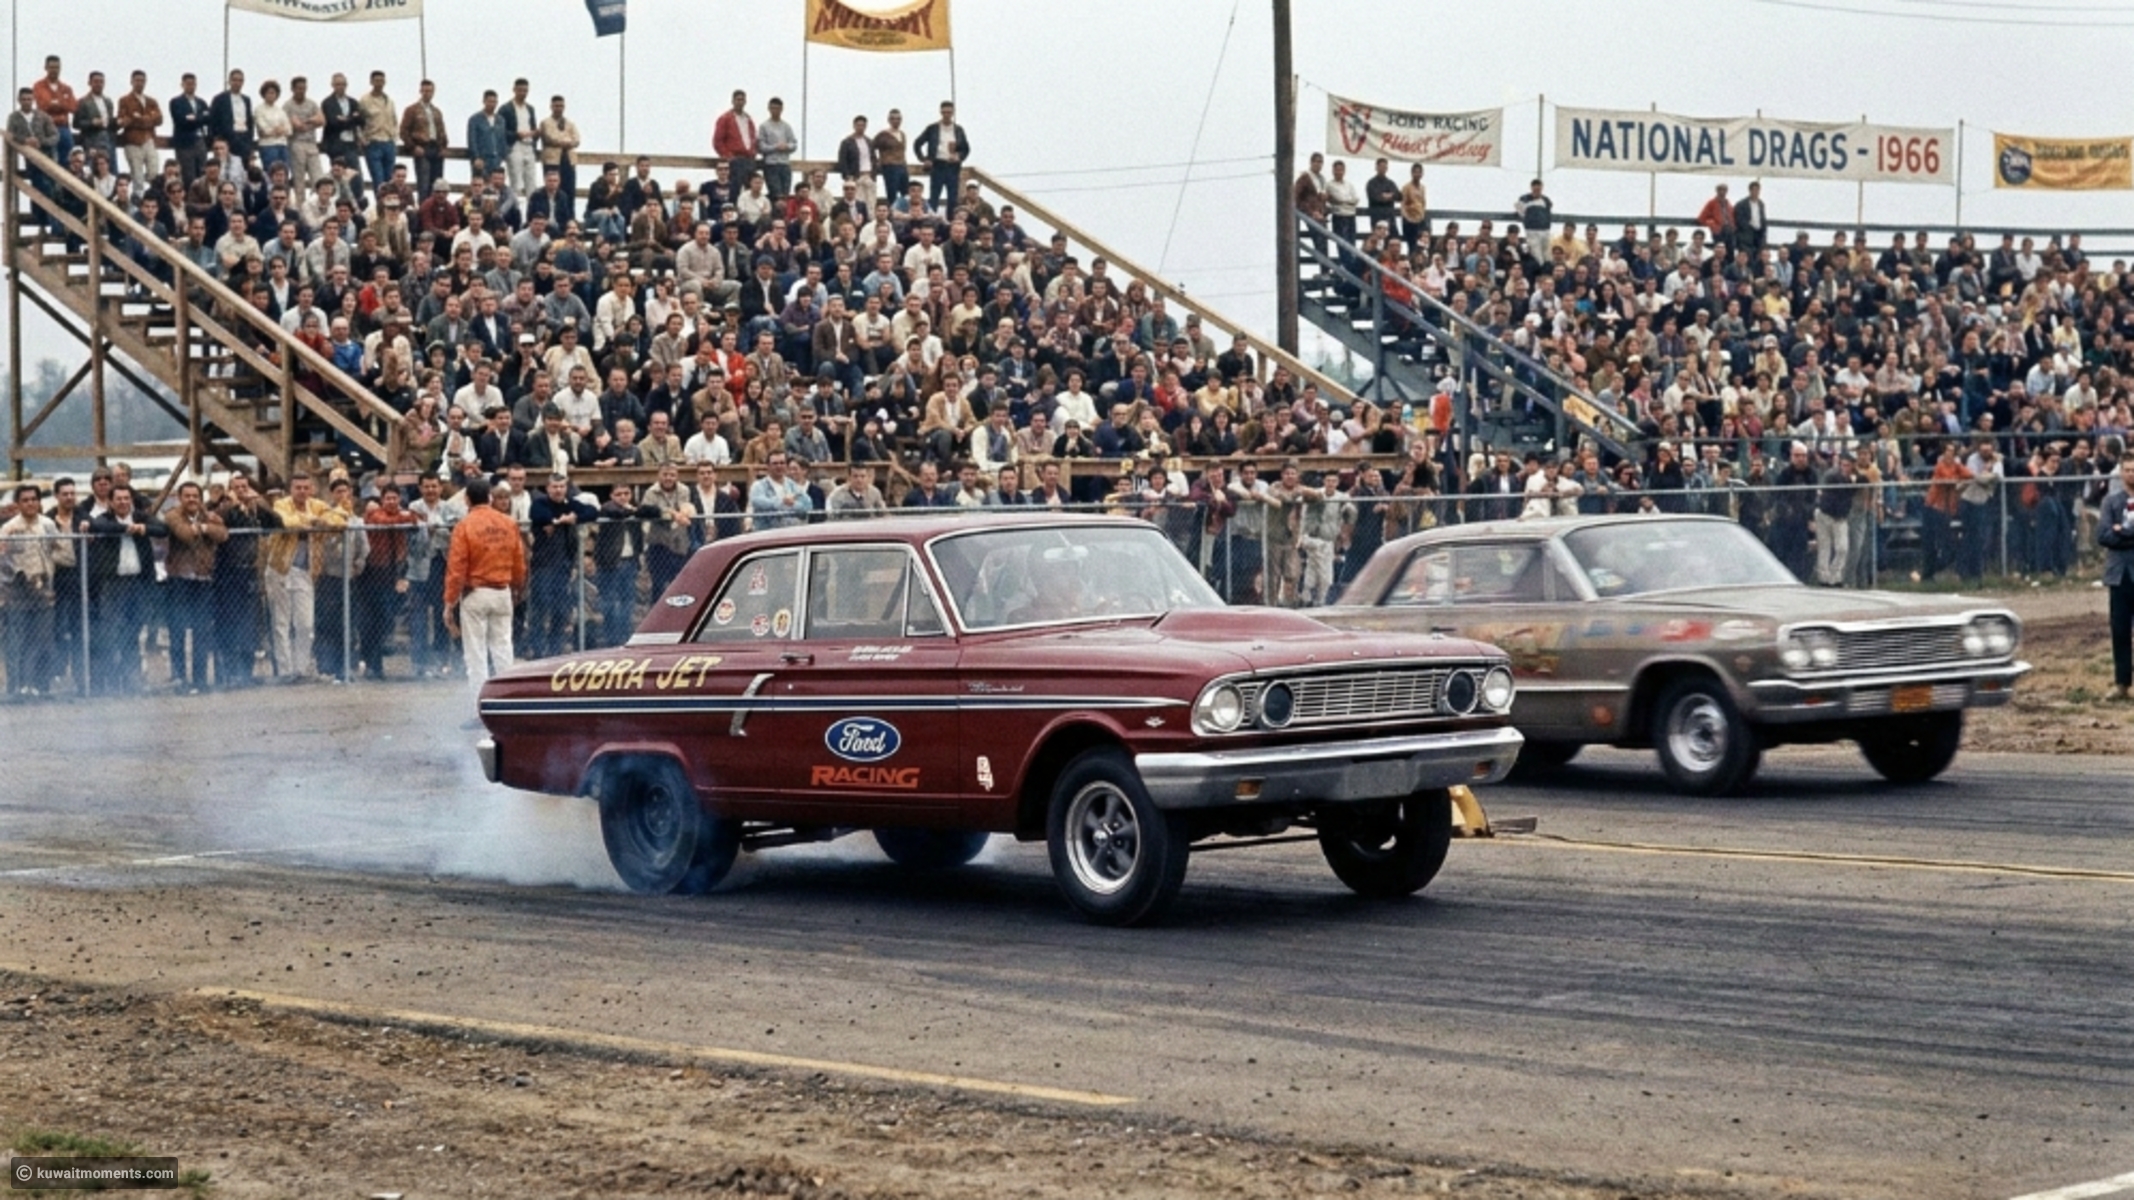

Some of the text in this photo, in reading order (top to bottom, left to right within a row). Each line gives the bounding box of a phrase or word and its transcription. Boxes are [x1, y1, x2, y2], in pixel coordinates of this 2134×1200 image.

[1433, 115, 1489, 132] RACING
[1572, 118, 1735, 166] NATIONAL
[1749, 128, 1848, 170] DRAGS
[1877, 135, 1940, 173] 1966
[551, 656, 722, 692] COBRA JET
[839, 722, 887, 754] Ford
[811, 765, 920, 788] RACING
